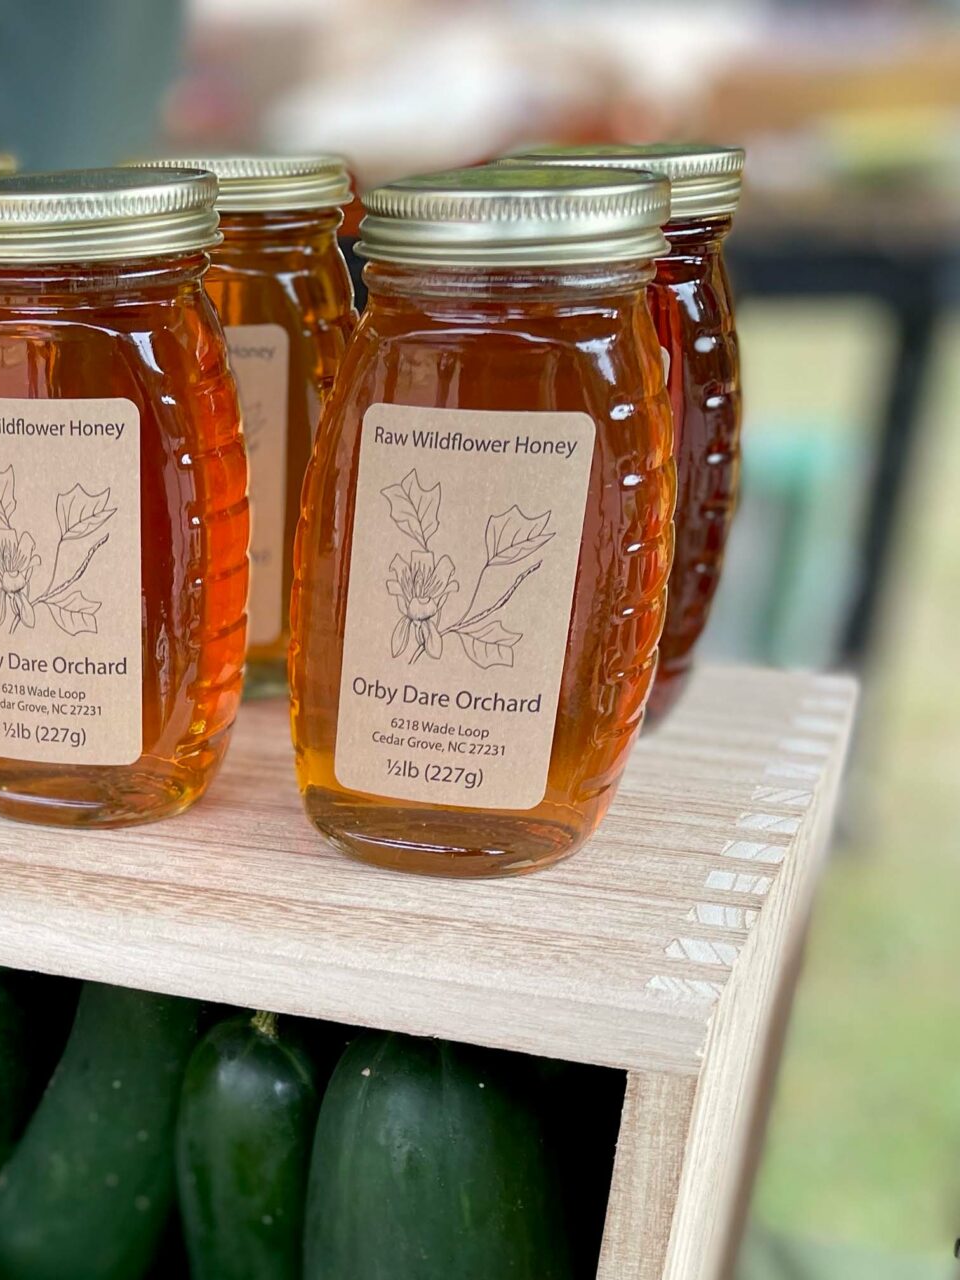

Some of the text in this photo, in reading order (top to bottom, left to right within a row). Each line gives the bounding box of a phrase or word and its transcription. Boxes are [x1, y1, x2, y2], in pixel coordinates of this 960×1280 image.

[70, 420, 125, 440] Honey
[374, 426, 577, 458] Raw Wildflower Honey
[8, 652, 48, 673] Dare
[53, 656, 127, 675] Orchard
[2, 683, 86, 702] 6218 Wade Loop
[352, 677, 541, 713] Orby Dare Orchard
[17, 701, 49, 715] Grove,
[52, 704, 68, 715] NC
[70, 706, 102, 716] 27231
[35, 725, 86, 747] (227g)
[391, 717, 489, 740] 6218 Wade Loop
[372, 731, 505, 756] Cedar Grove, NC 27231
[425, 764, 483, 788] (227g)
